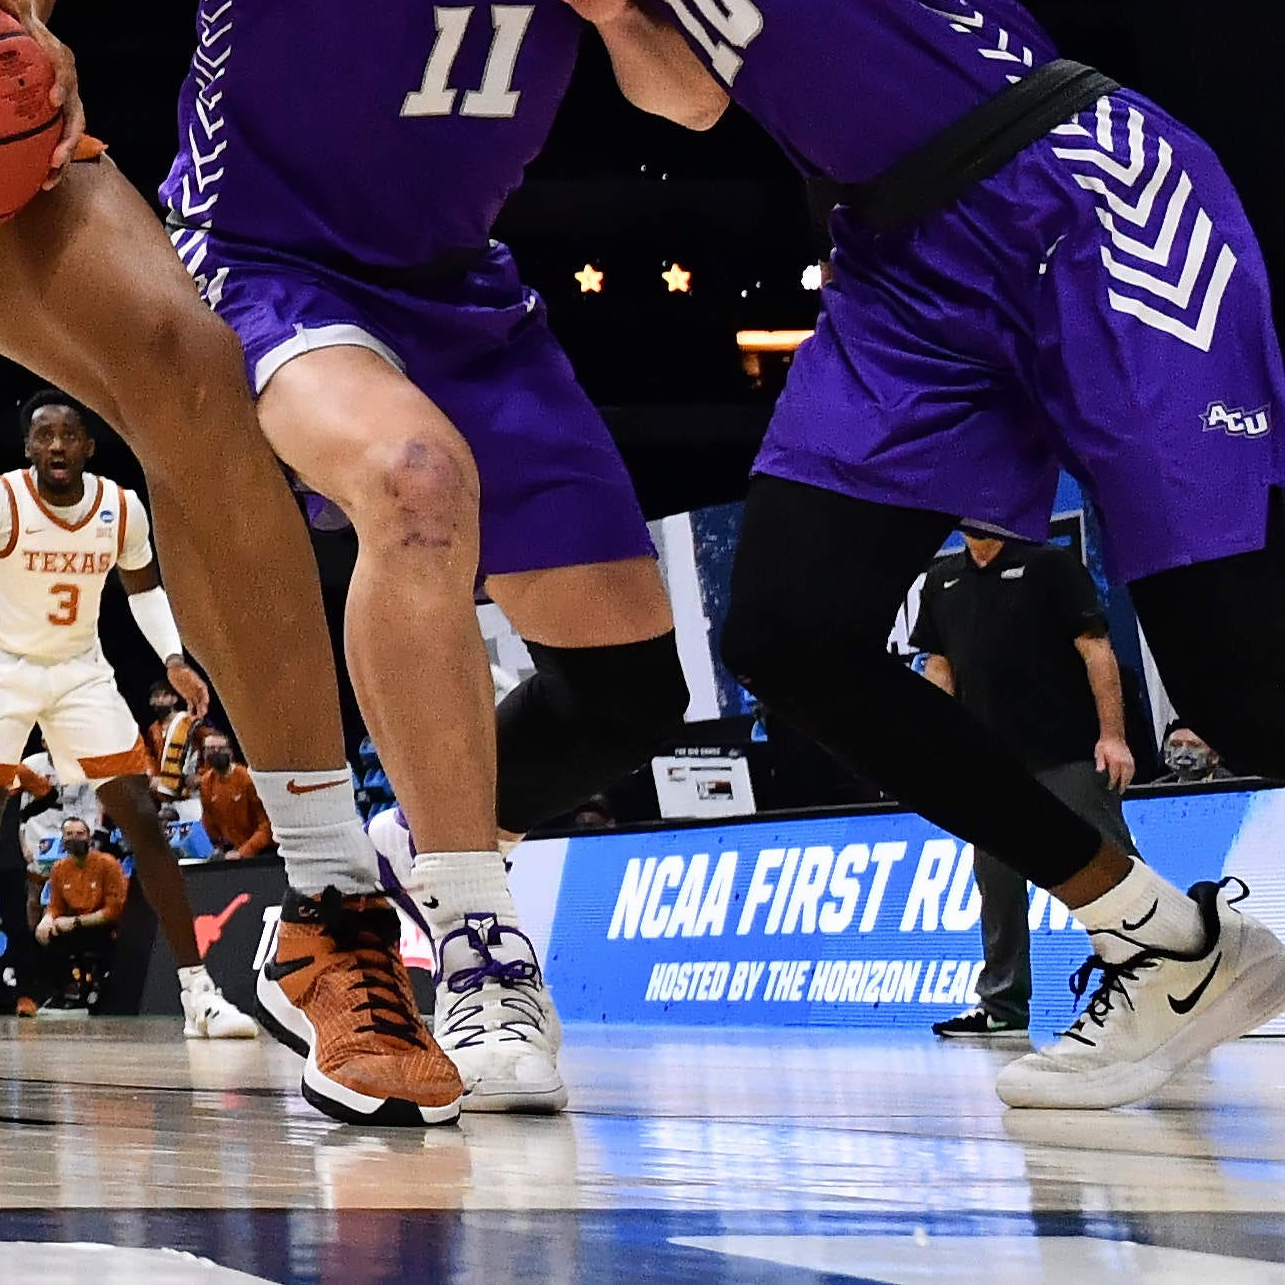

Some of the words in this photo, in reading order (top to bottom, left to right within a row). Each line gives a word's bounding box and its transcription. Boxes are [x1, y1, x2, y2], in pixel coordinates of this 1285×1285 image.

[399, 5, 535, 118] 11
[1205, 402, 1270, 436] ACU
[23, 551, 111, 574] TEXAS
[48, 583, 80, 626] 3
[606, 851, 738, 940] NCAA
[735, 841, 907, 936] FIRST
[645, 961, 730, 1002] HOSTED
[727, 960, 766, 1002] BY
[763, 960, 811, 1002] THE
[806, 960, 923, 1003] HORIZON
